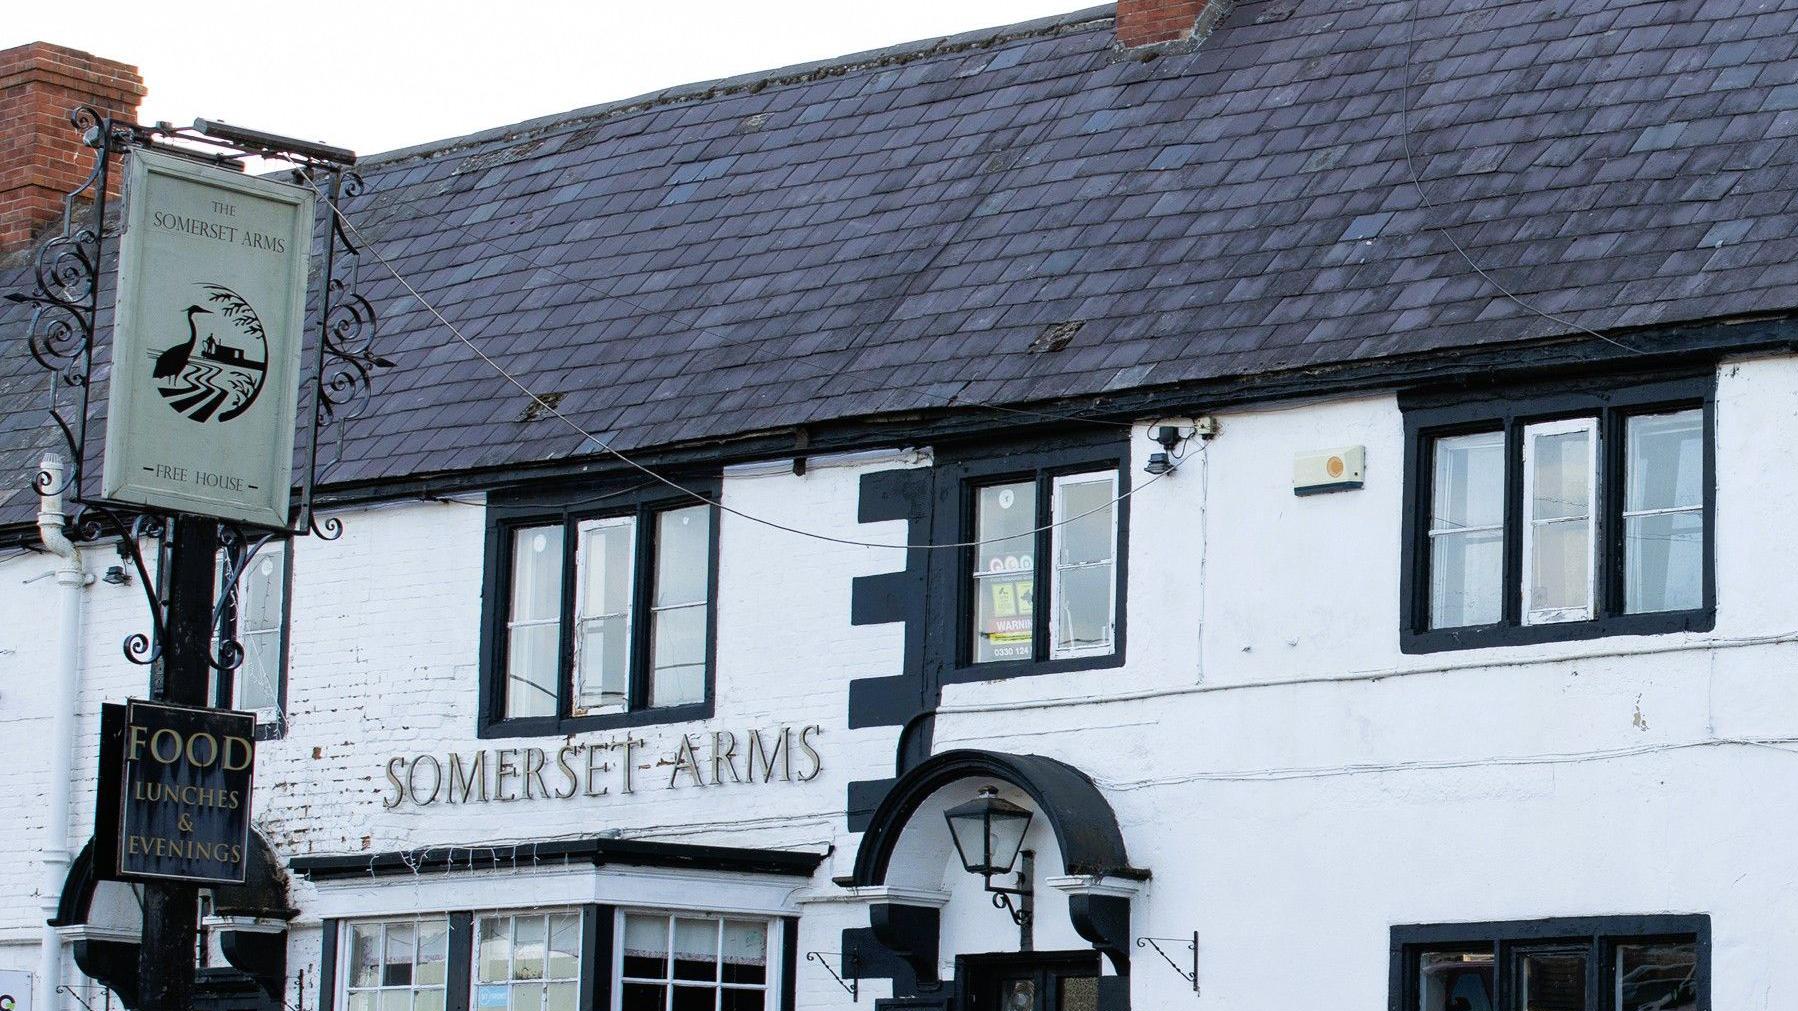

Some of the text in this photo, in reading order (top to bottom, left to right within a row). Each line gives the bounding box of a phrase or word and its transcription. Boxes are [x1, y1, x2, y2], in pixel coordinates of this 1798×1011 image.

[212, 200, 237, 217] THE
[153, 210, 286, 254] SOMERSET ARMS
[156, 464, 244, 492] FREE HOUSE
[127, 725, 253, 771] FOOD
[382, 724, 824, 809] SOMERSET ARMS
[135, 781, 240, 810] LUNCHES
[178, 812, 194, 832] &
[128, 835, 241, 863] EVENINGS
